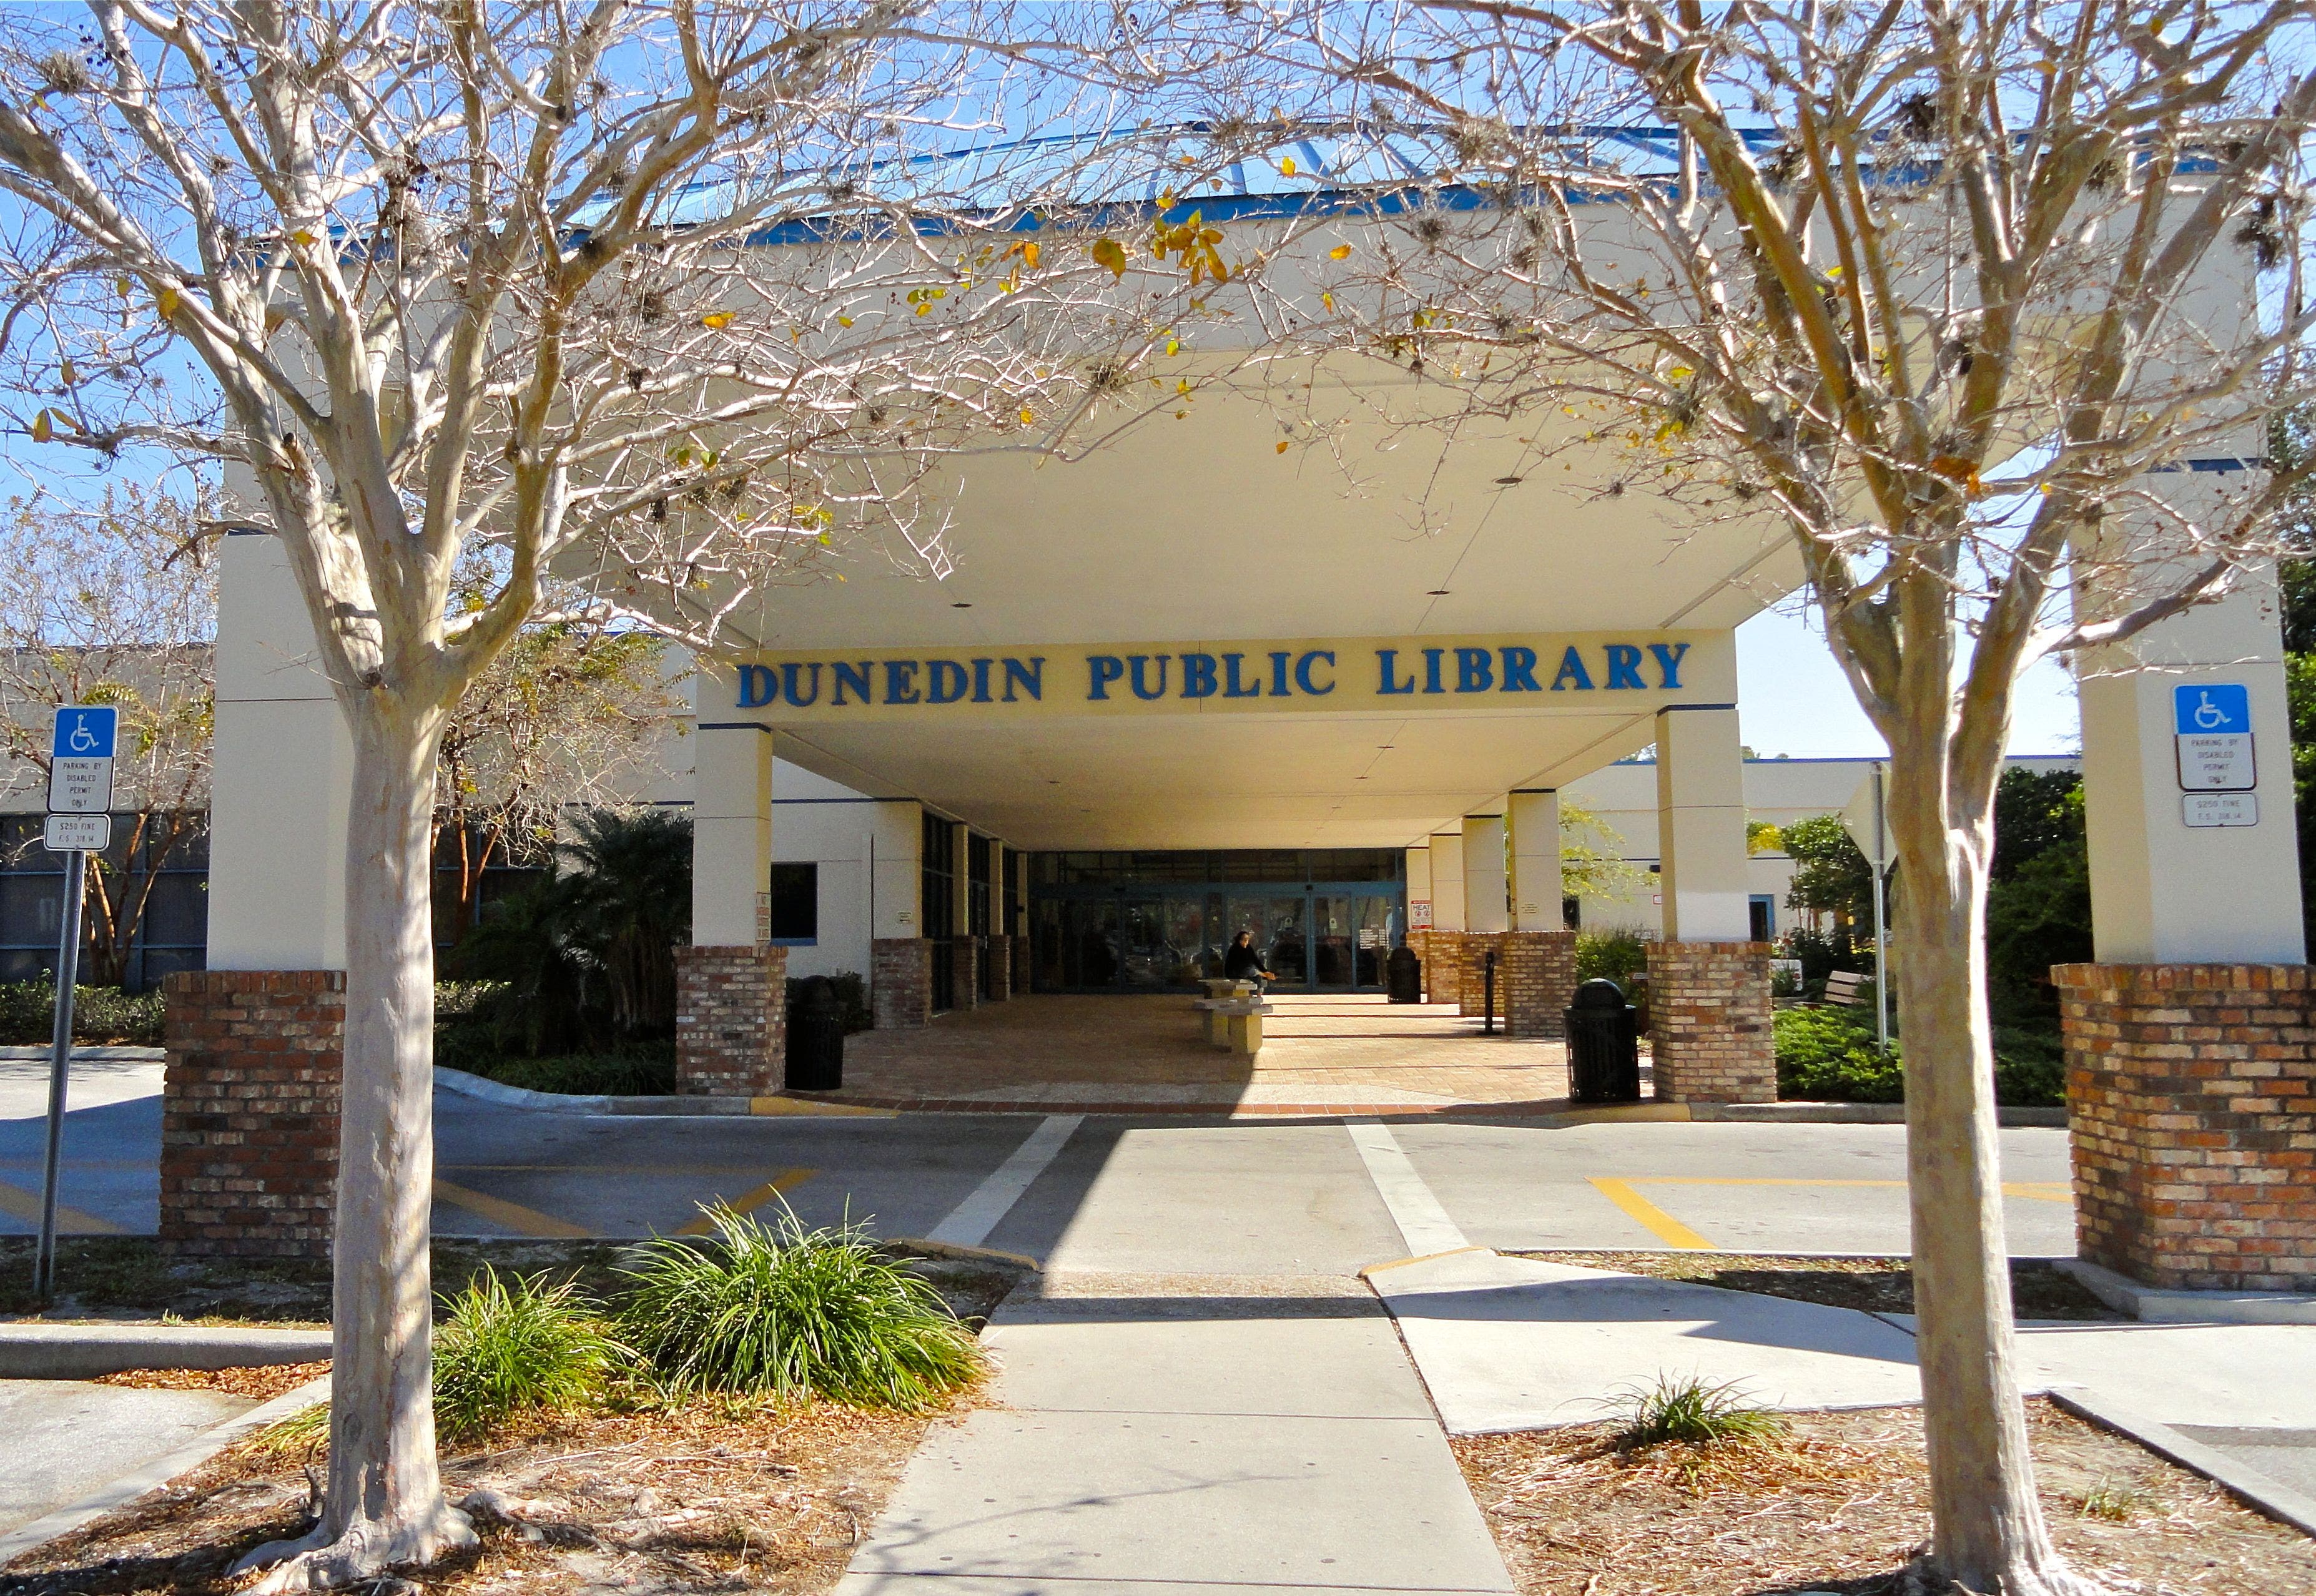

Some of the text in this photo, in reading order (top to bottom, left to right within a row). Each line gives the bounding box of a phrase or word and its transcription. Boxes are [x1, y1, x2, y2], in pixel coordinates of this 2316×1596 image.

[735, 643, 1691, 709] DUNEDIN PUBLIC LIBRARY
[71, 799, 87, 807] ONLY
[59, 822, 78, 830] $250
